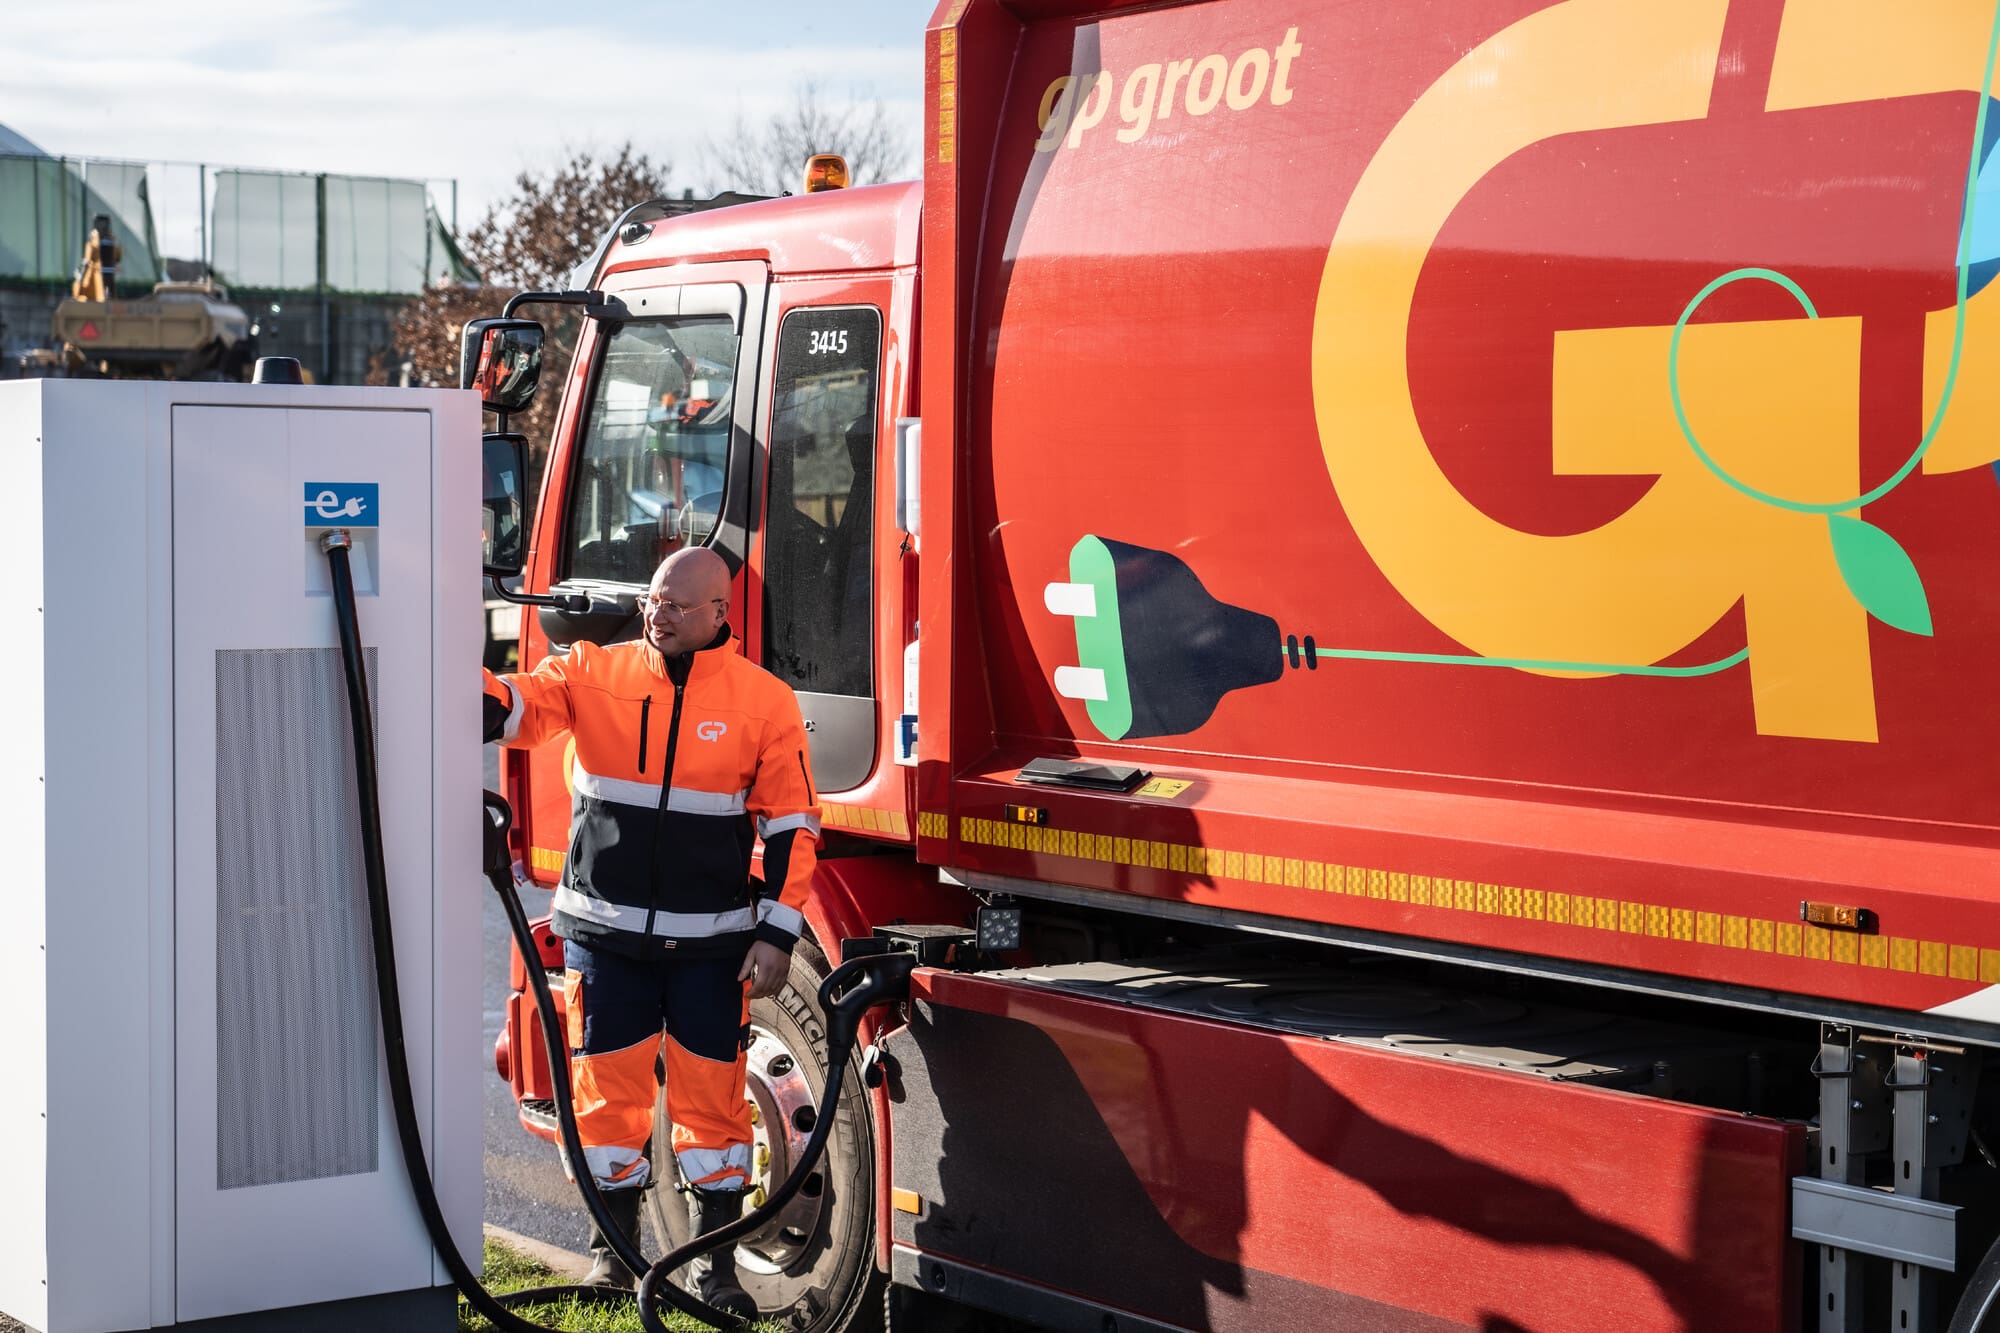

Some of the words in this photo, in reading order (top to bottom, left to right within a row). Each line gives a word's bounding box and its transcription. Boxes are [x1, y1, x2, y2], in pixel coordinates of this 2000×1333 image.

[1034, 69, 1113, 152] gp
[1116, 26, 1303, 144] groot
[808, 330, 848, 355] 3415
[696, 721, 727, 742] GP
